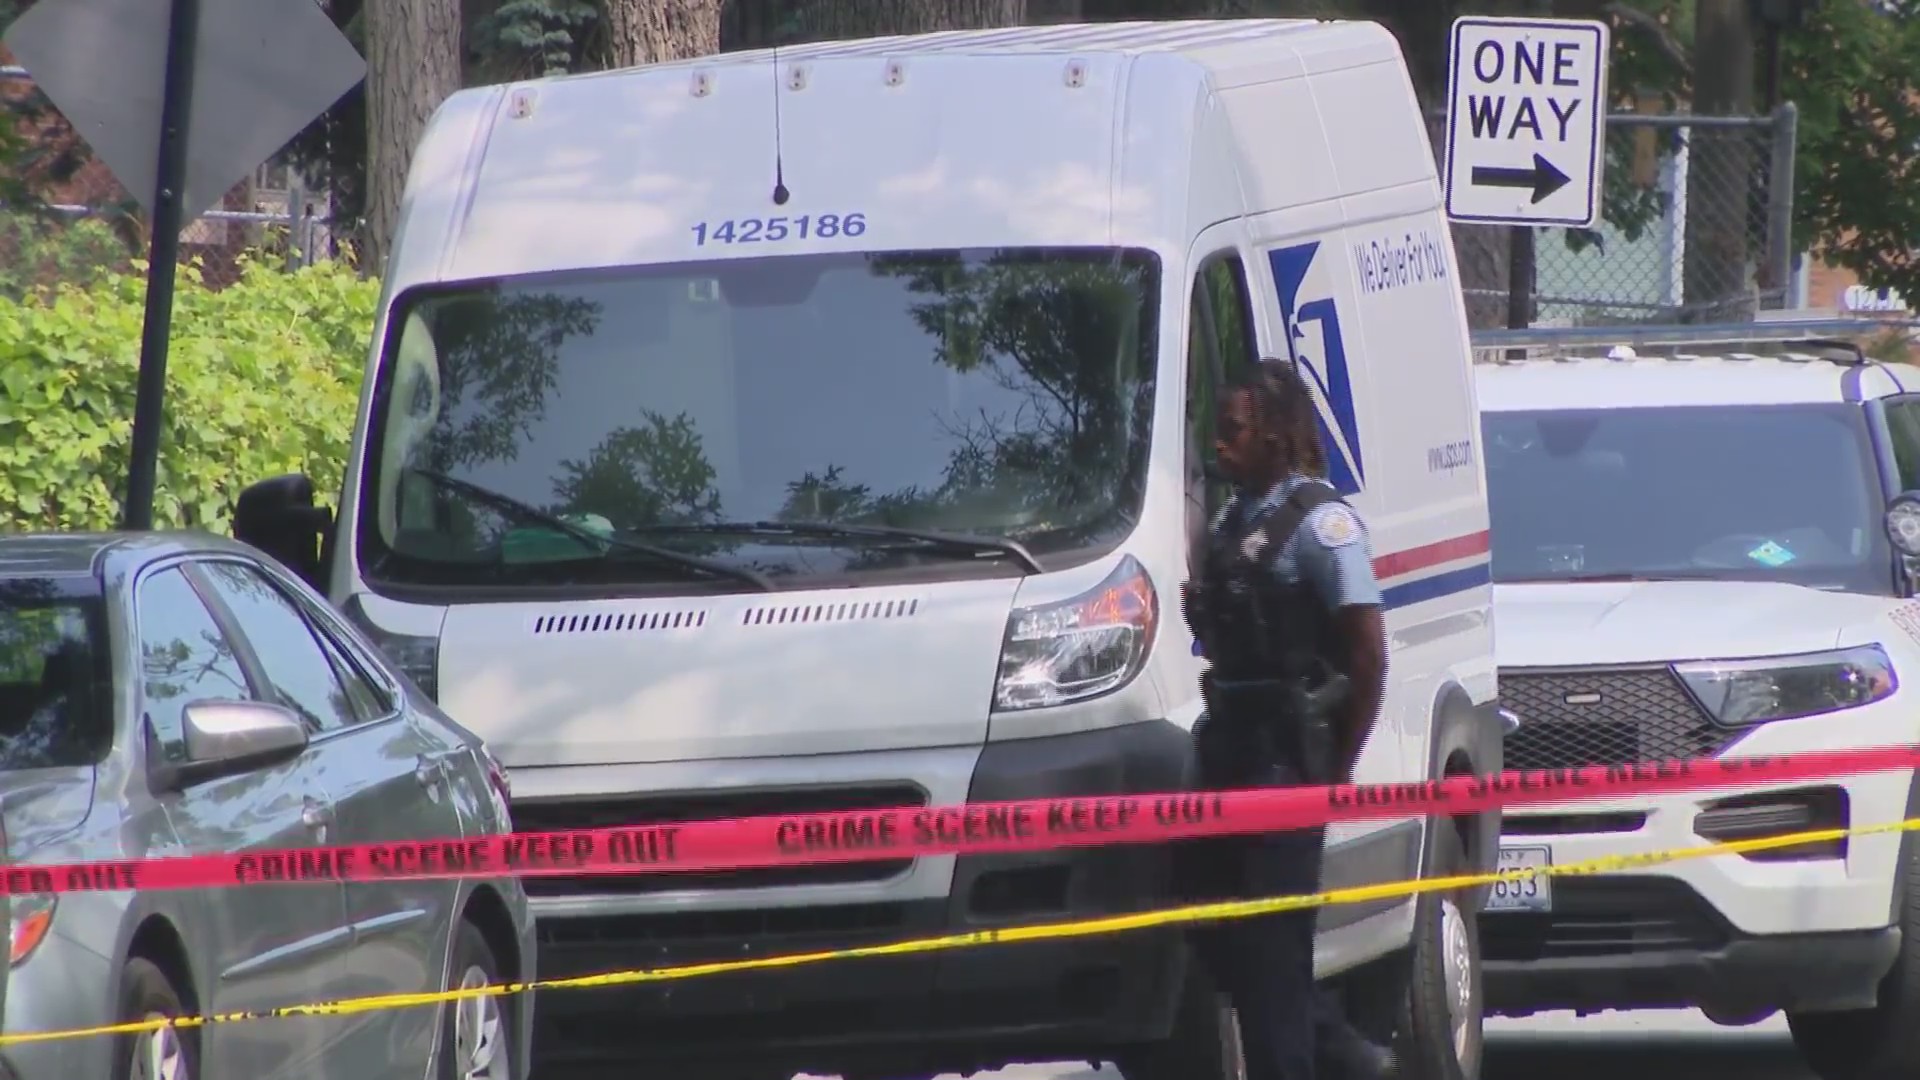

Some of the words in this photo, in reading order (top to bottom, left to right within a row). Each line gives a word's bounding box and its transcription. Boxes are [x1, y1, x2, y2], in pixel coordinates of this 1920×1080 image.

[1474, 40, 1580, 86] ONE
[1468, 95, 1581, 141] WAY
[691, 213, 866, 246] 1425186
[1354, 243, 1375, 293] We
[1371, 236, 1408, 290] Deliver
[1405, 234, 1423, 283] For
[776, 813, 896, 851] CRIME
[913, 804, 1034, 845] SCENE
[1047, 796, 1139, 833] KEEP
[236, 850, 354, 882] CRIME
[369, 840, 488, 877] SCENE
[503, 833, 594, 867] KEEP
[608, 826, 678, 863] OUT
